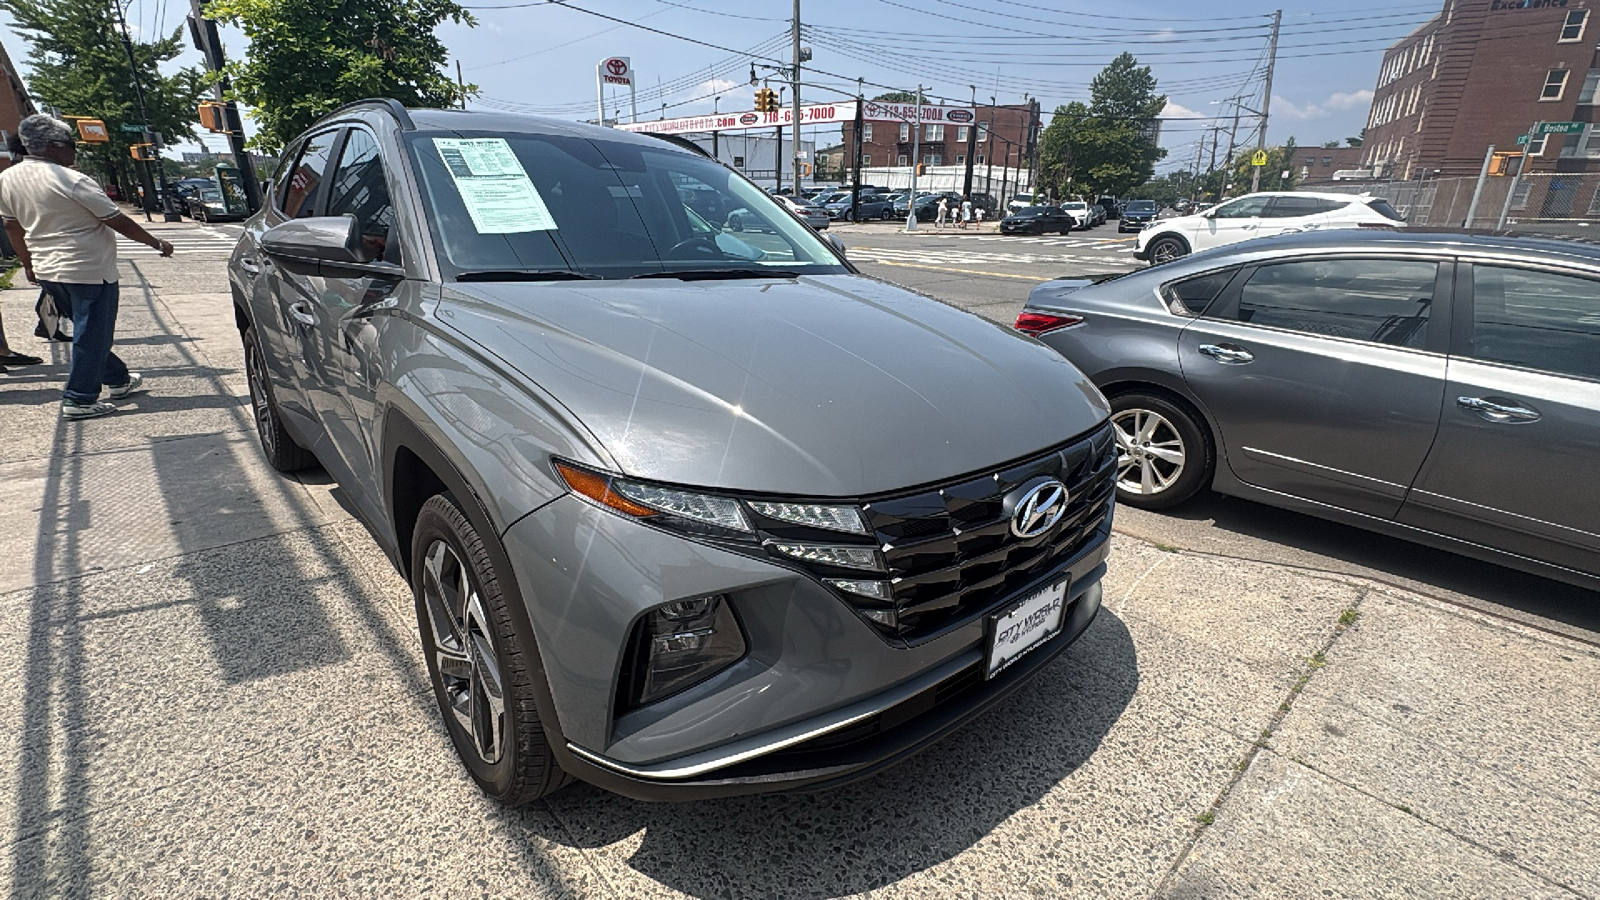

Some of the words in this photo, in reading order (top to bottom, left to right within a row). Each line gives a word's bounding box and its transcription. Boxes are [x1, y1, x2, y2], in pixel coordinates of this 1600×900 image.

[603, 75, 630, 85] TOYOTA
[1543, 123, 1569, 133] Boston
[999, 620, 1023, 643] CITY
